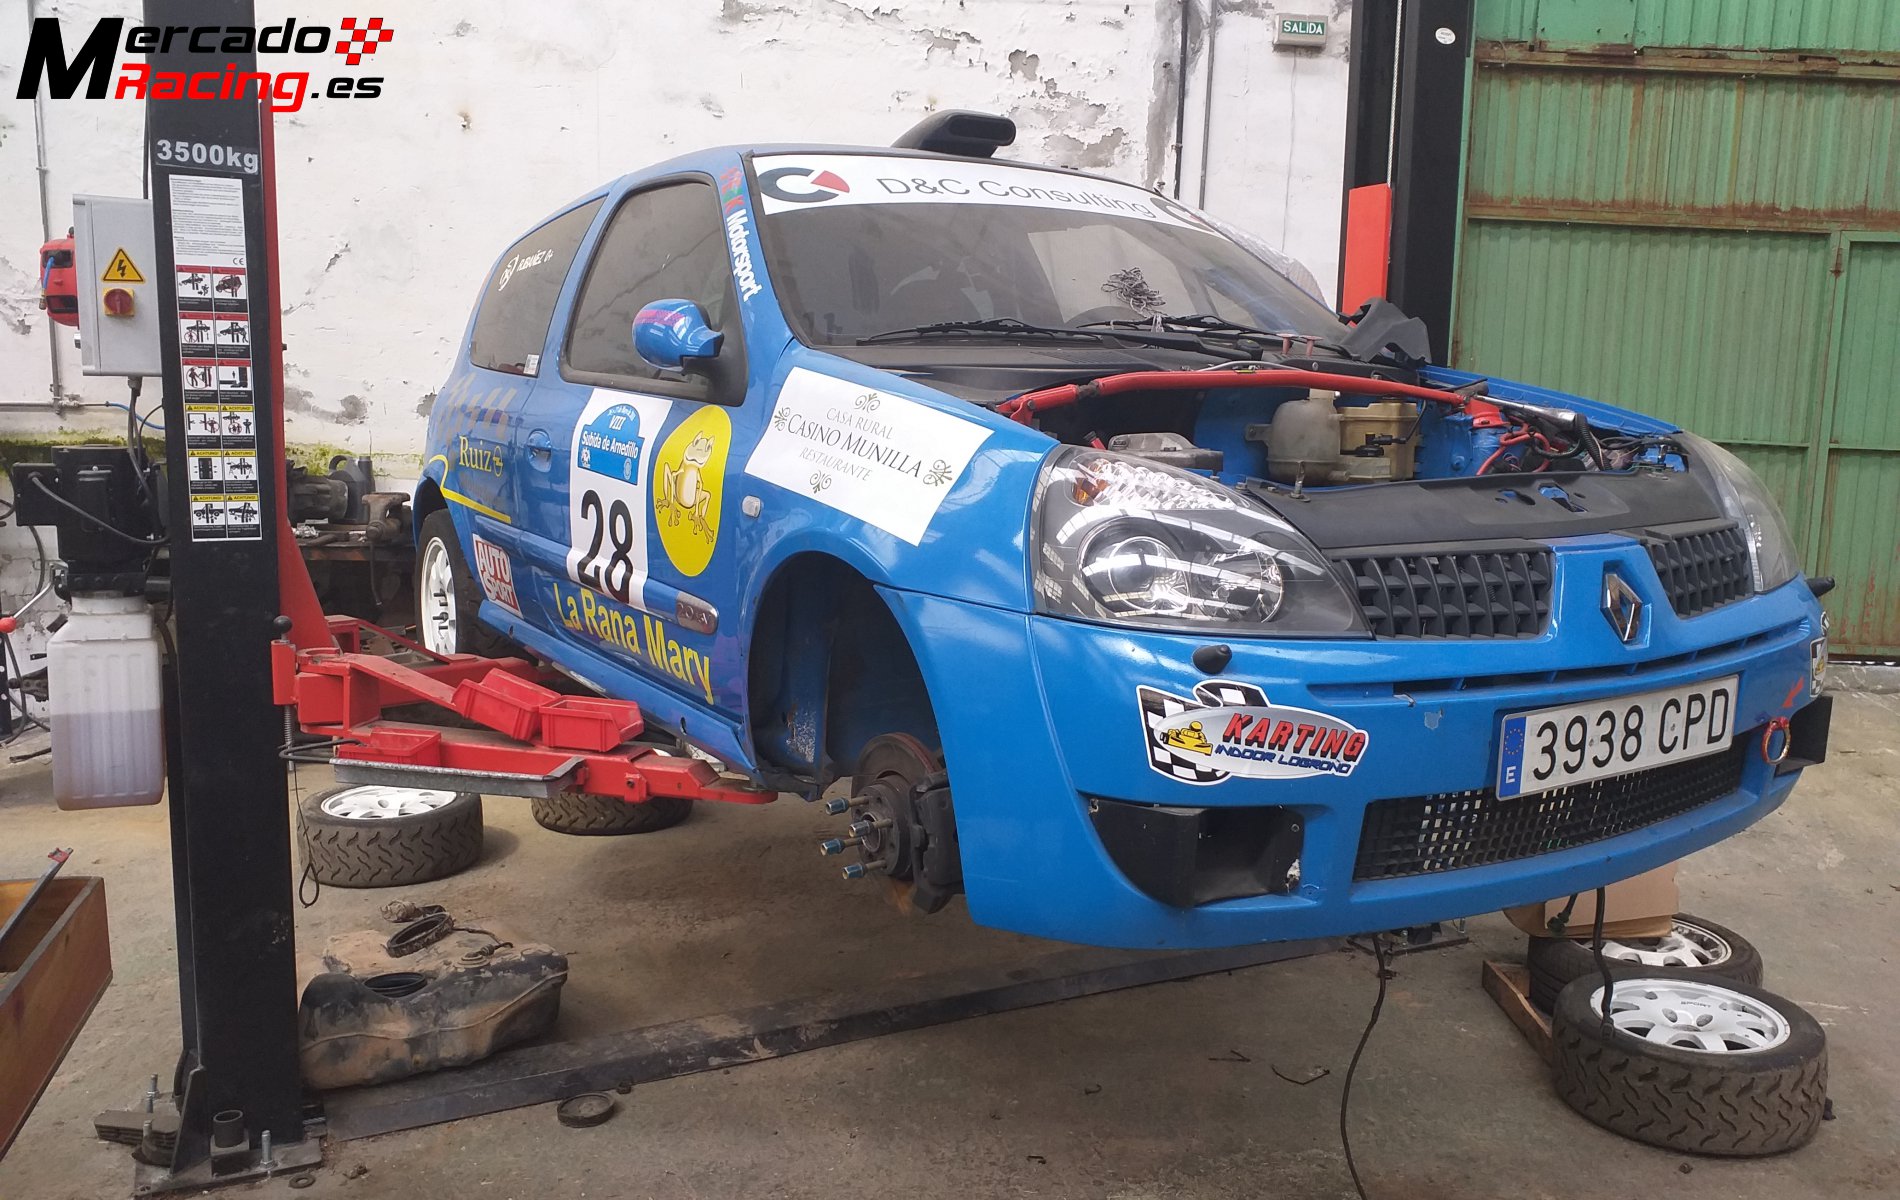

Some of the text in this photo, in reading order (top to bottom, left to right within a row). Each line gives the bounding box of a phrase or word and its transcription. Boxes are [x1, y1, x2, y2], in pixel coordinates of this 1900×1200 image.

[1283, 21, 1323, 35] SALIDA
[157, 139, 259, 174] 3500kg
[876, 178, 1157, 218] D&C Consulting
[232, 257, 245, 266] CE
[726, 208, 762, 302] Motorsport
[609, 415, 627, 430] VIII
[826, 407, 894, 440] CASA RURAL
[458, 435, 492, 472] Ruiz
[581, 430, 639, 459] Subida de Arnedillo
[787, 413, 923, 478] CASINO MUNILLA
[799, 447, 873, 482] RESTAURANTE
[477, 541, 511, 584] AUTO
[577, 490, 634, 604] 28
[482, 570, 516, 607] SPORT
[553, 582, 714, 705] La Rana Mary
[1222, 712, 1365, 762] KARTING
[1533, 688, 1729, 781] 3938 CPD
[1214, 744, 1276, 763] INDOOR
[1505, 766, 1517, 784] E
